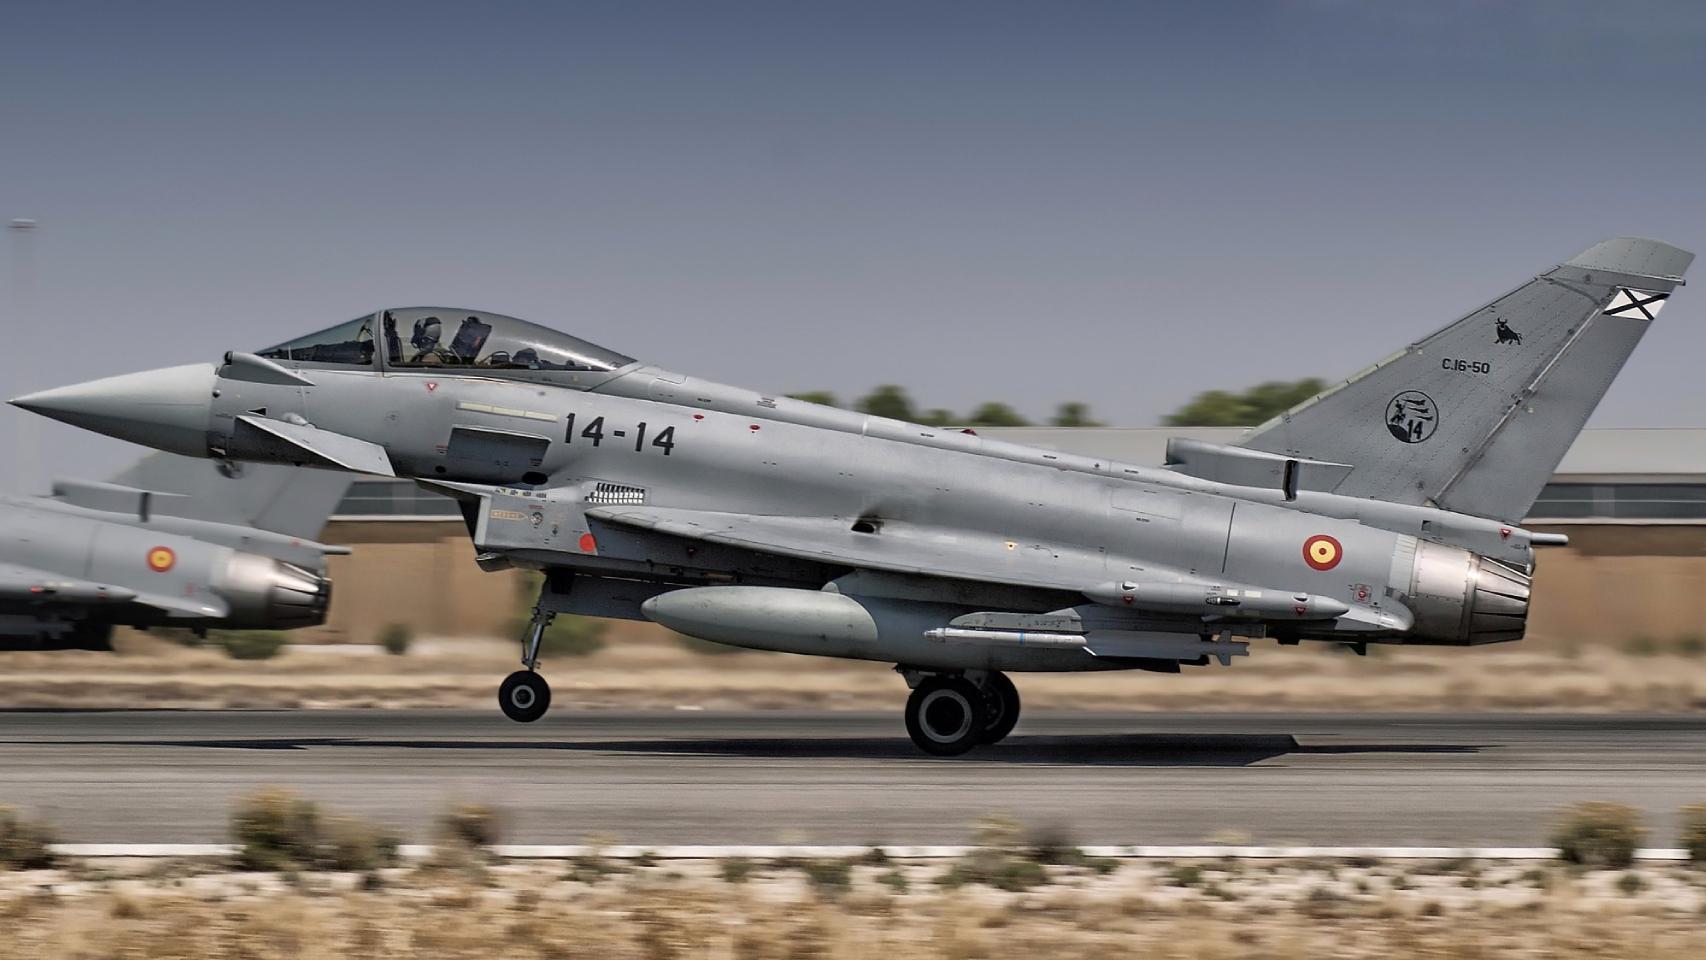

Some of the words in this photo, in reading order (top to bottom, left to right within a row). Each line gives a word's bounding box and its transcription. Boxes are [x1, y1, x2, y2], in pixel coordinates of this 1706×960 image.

[1442, 358, 1490, 374] C.16-50
[564, 412, 675, 456] 14-14
[1407, 419, 1424, 440] 14
